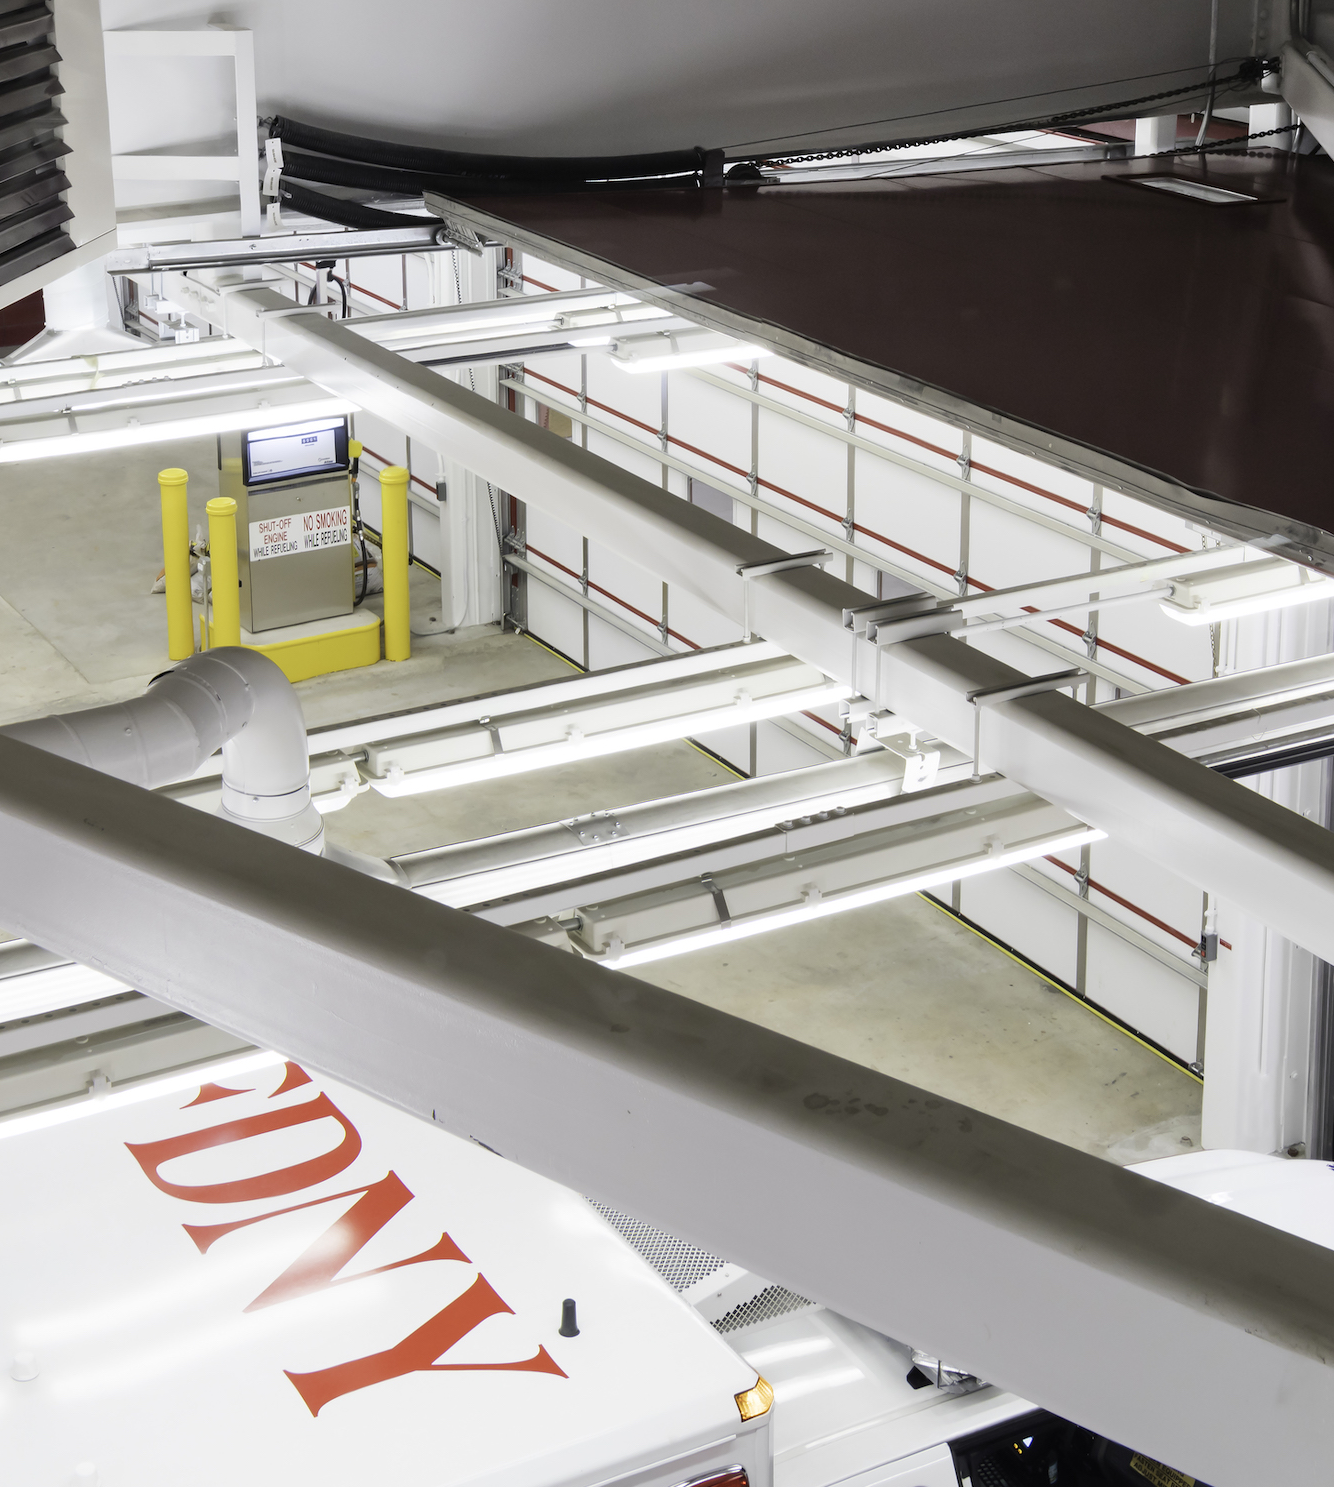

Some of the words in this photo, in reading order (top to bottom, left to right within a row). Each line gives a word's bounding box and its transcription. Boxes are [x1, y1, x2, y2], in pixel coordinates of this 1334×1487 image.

[259, 518, 292, 534] SHUT-OFF
[303, 515, 314, 532] NO
[316, 509, 348, 530] SMOKING
[264, 531, 288, 545] ENGINE
[304, 532, 319, 549] WHILE
[321, 528, 348, 546] REFUELING
[253, 546, 269, 558] WHILE
[271, 541, 298, 554] REFUELING
